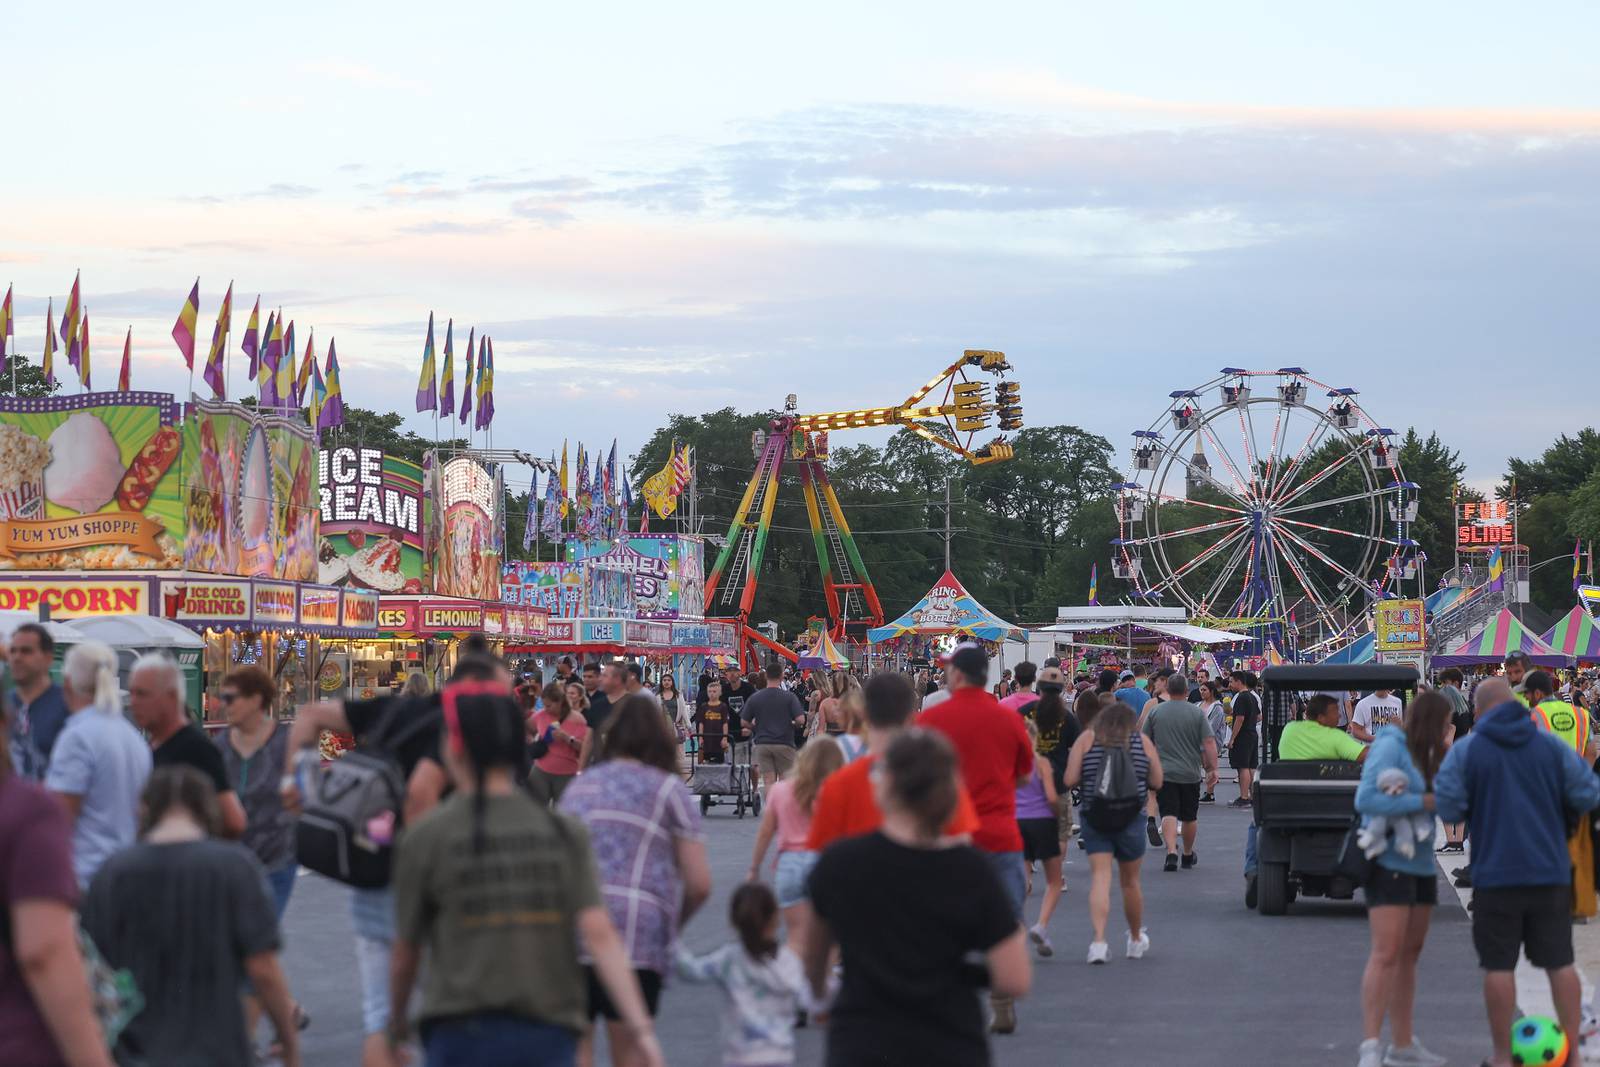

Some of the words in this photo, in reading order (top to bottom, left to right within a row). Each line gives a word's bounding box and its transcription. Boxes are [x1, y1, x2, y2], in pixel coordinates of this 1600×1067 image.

[319, 447, 381, 485] ICE
[1464, 501, 1508, 520] FUN
[12, 528, 43, 542] YUM
[48, 525, 79, 541] YUM
[83, 521, 140, 535] SHOPPE
[1459, 523, 1513, 543] SLIDE
[191, 587, 210, 598] ICE
[212, 587, 241, 599] COLD
[931, 586, 957, 598] RING
[186, 600, 245, 615] DRINKS
[345, 600, 375, 622] NACHOS
[936, 599, 945, 609] A
[919, 614, 958, 624] BOTTLE
[591, 624, 613, 640] ICEE
[1387, 631, 1419, 643] ATM
